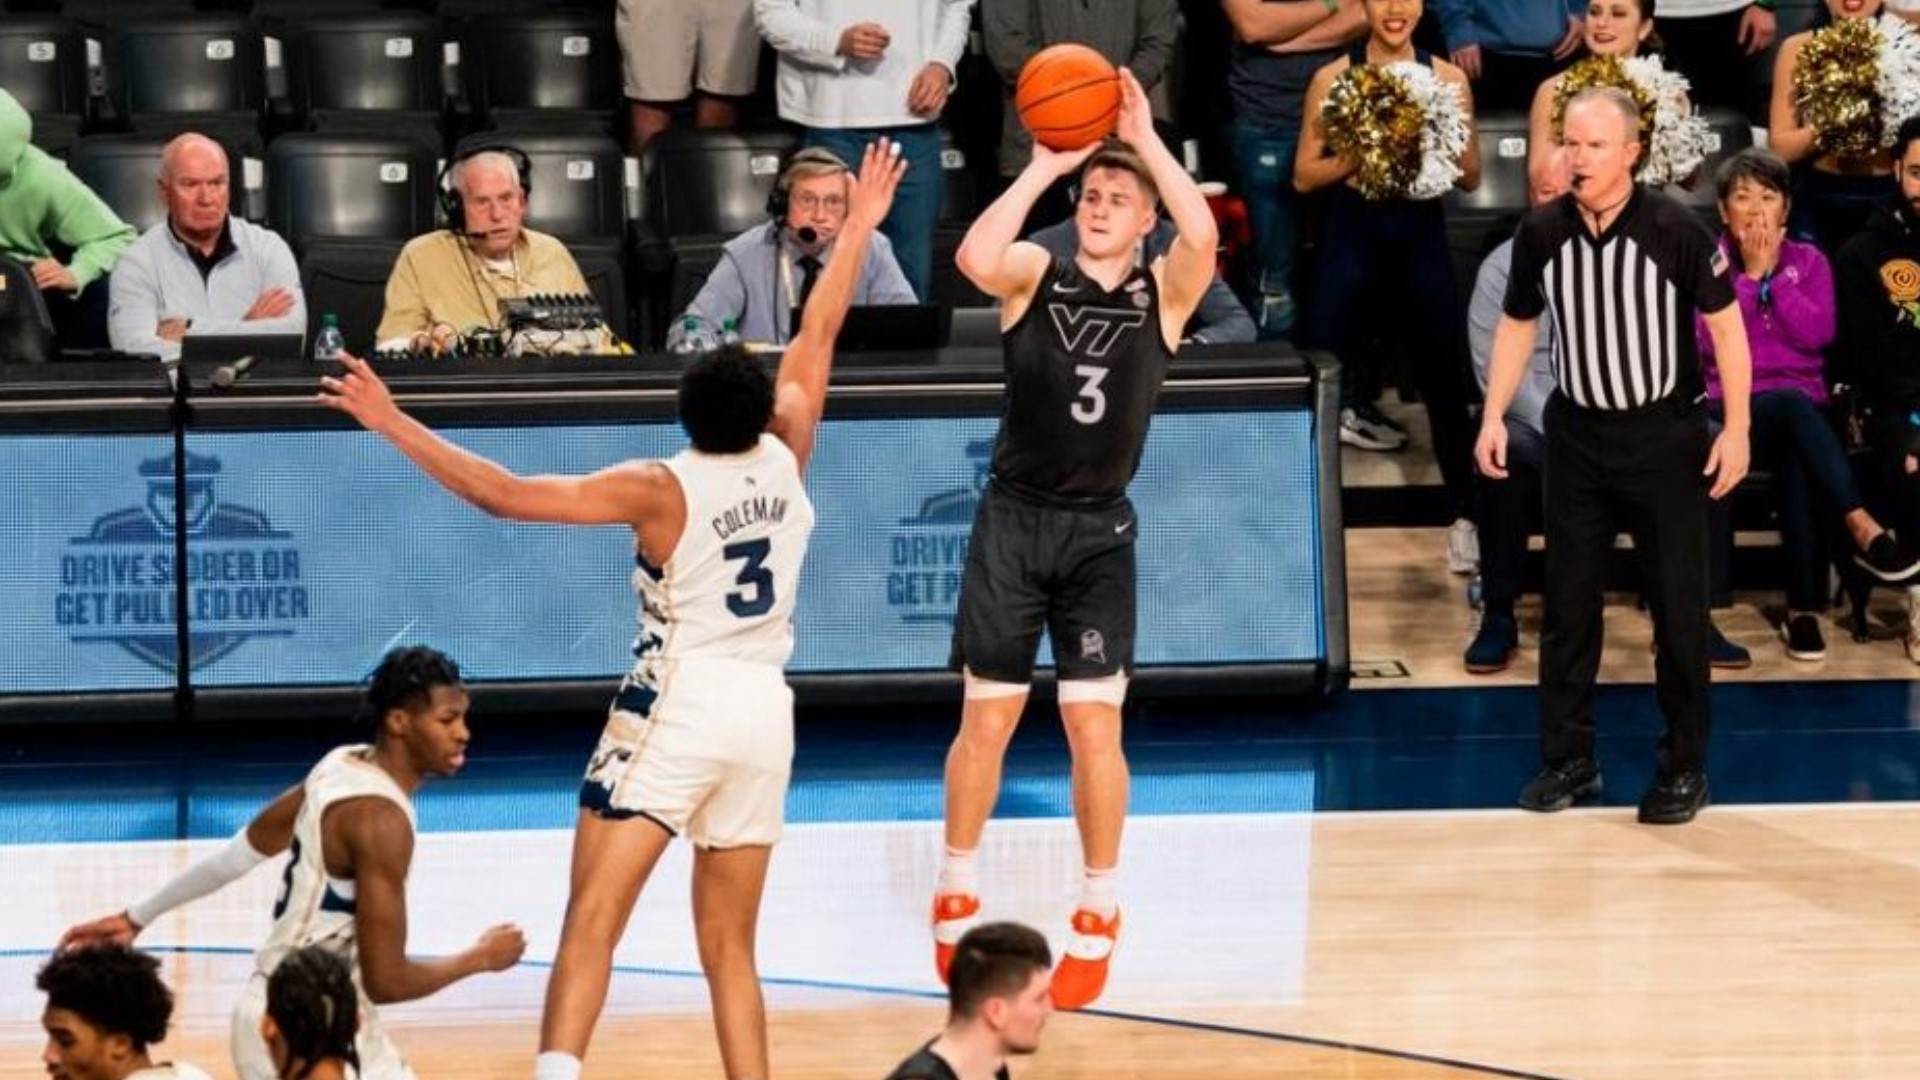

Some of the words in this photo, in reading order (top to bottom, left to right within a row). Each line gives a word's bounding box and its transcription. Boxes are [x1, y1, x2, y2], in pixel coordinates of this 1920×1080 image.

[388, 166, 399, 179] 6
[1049, 304, 1147, 357] VT
[1070, 364, 1110, 424] 3
[62, 554, 144, 587] DRIVE
[262, 549, 298, 581] OR
[722, 536, 776, 618] 3
[54, 592, 108, 625] GET
[235, 585, 309, 620] OVER
[887, 572, 937, 605] GET
